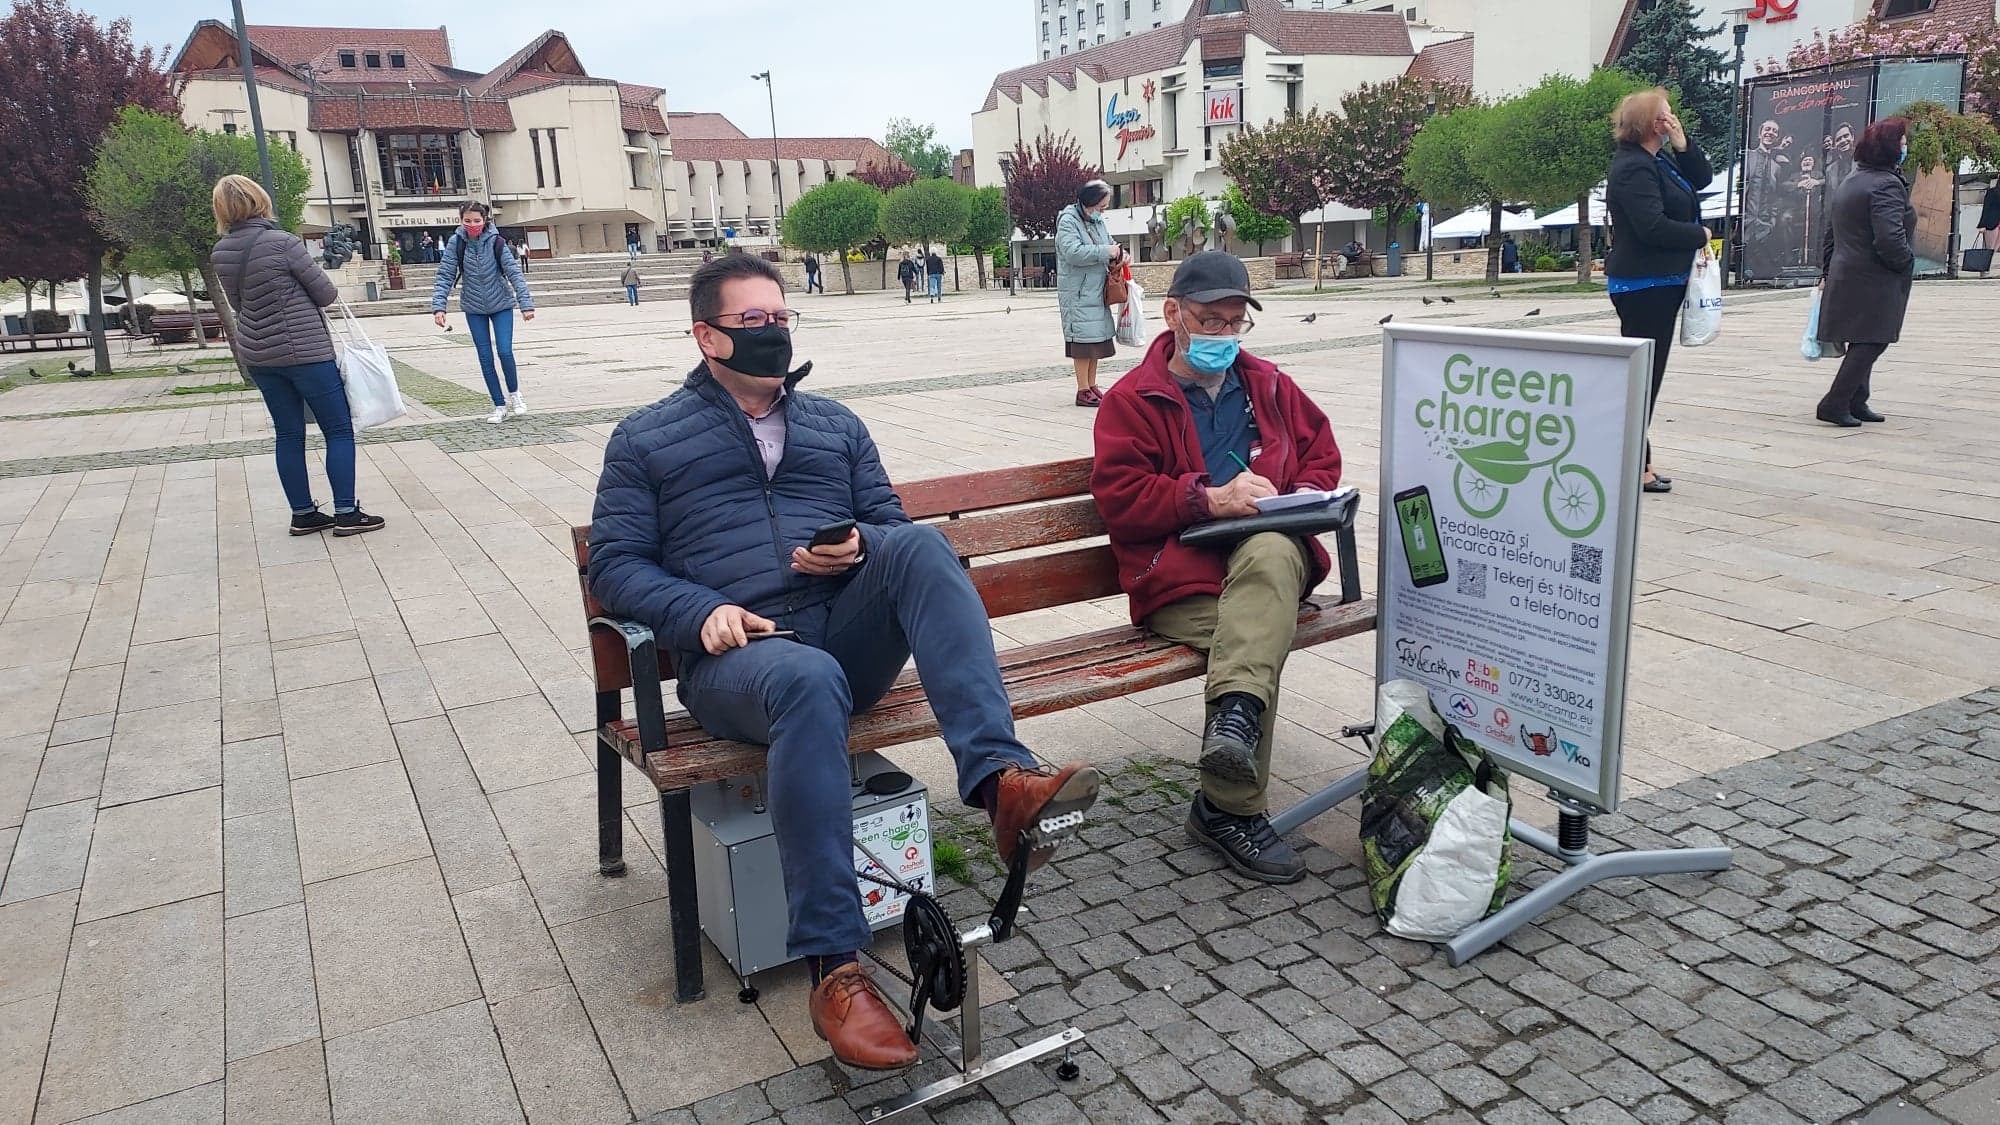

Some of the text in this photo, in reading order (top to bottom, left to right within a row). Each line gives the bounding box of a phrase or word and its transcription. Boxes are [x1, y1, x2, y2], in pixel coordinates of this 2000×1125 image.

[1210, 94, 1235, 119] kik
[389, 217, 429, 226] TEATRUL
[1443, 353, 1573, 407] Green
[1415, 390, 1563, 450] charge
[1439, 516, 1529, 549] Pedalează și
[1442, 532, 1567, 574] încarcă telefonul
[1493, 566, 1601, 608] Tekerj és töltsd
[1510, 595, 1520, 607] a
[1524, 595, 1600, 629] telefonod
[1465, 671, 1499, 695] Camp
[1509, 671, 1594, 712] 0773 330824
[1510, 691, 1593, 725] www.forcamp.eu
[882, 821, 915, 838] charge
